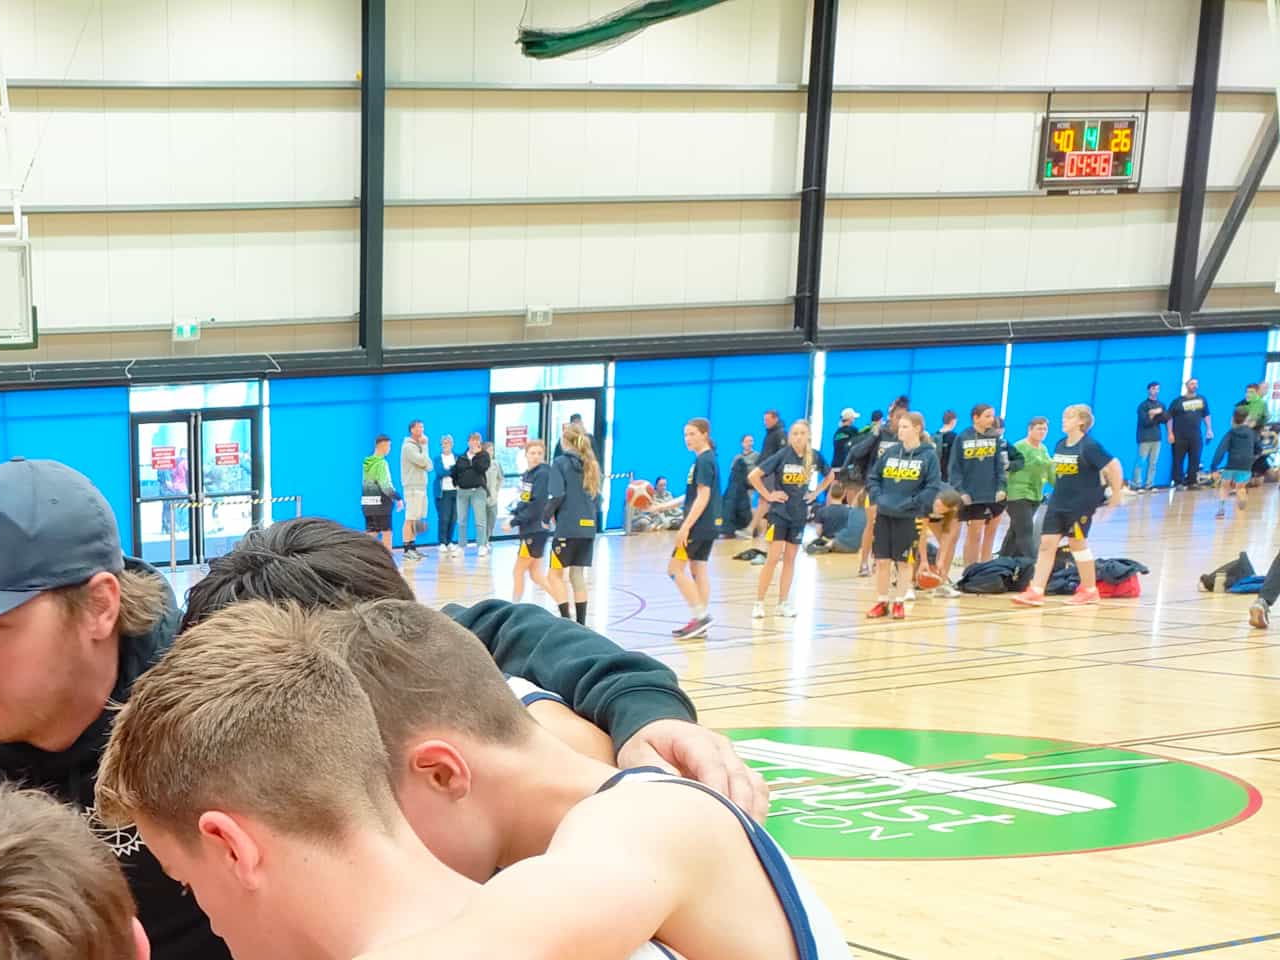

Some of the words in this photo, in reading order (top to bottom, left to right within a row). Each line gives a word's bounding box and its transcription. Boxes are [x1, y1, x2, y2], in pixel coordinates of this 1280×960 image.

[1054, 130, 1074, 152] 40
[1085, 128, 1097, 149] 4
[1111, 129, 1131, 152] 26
